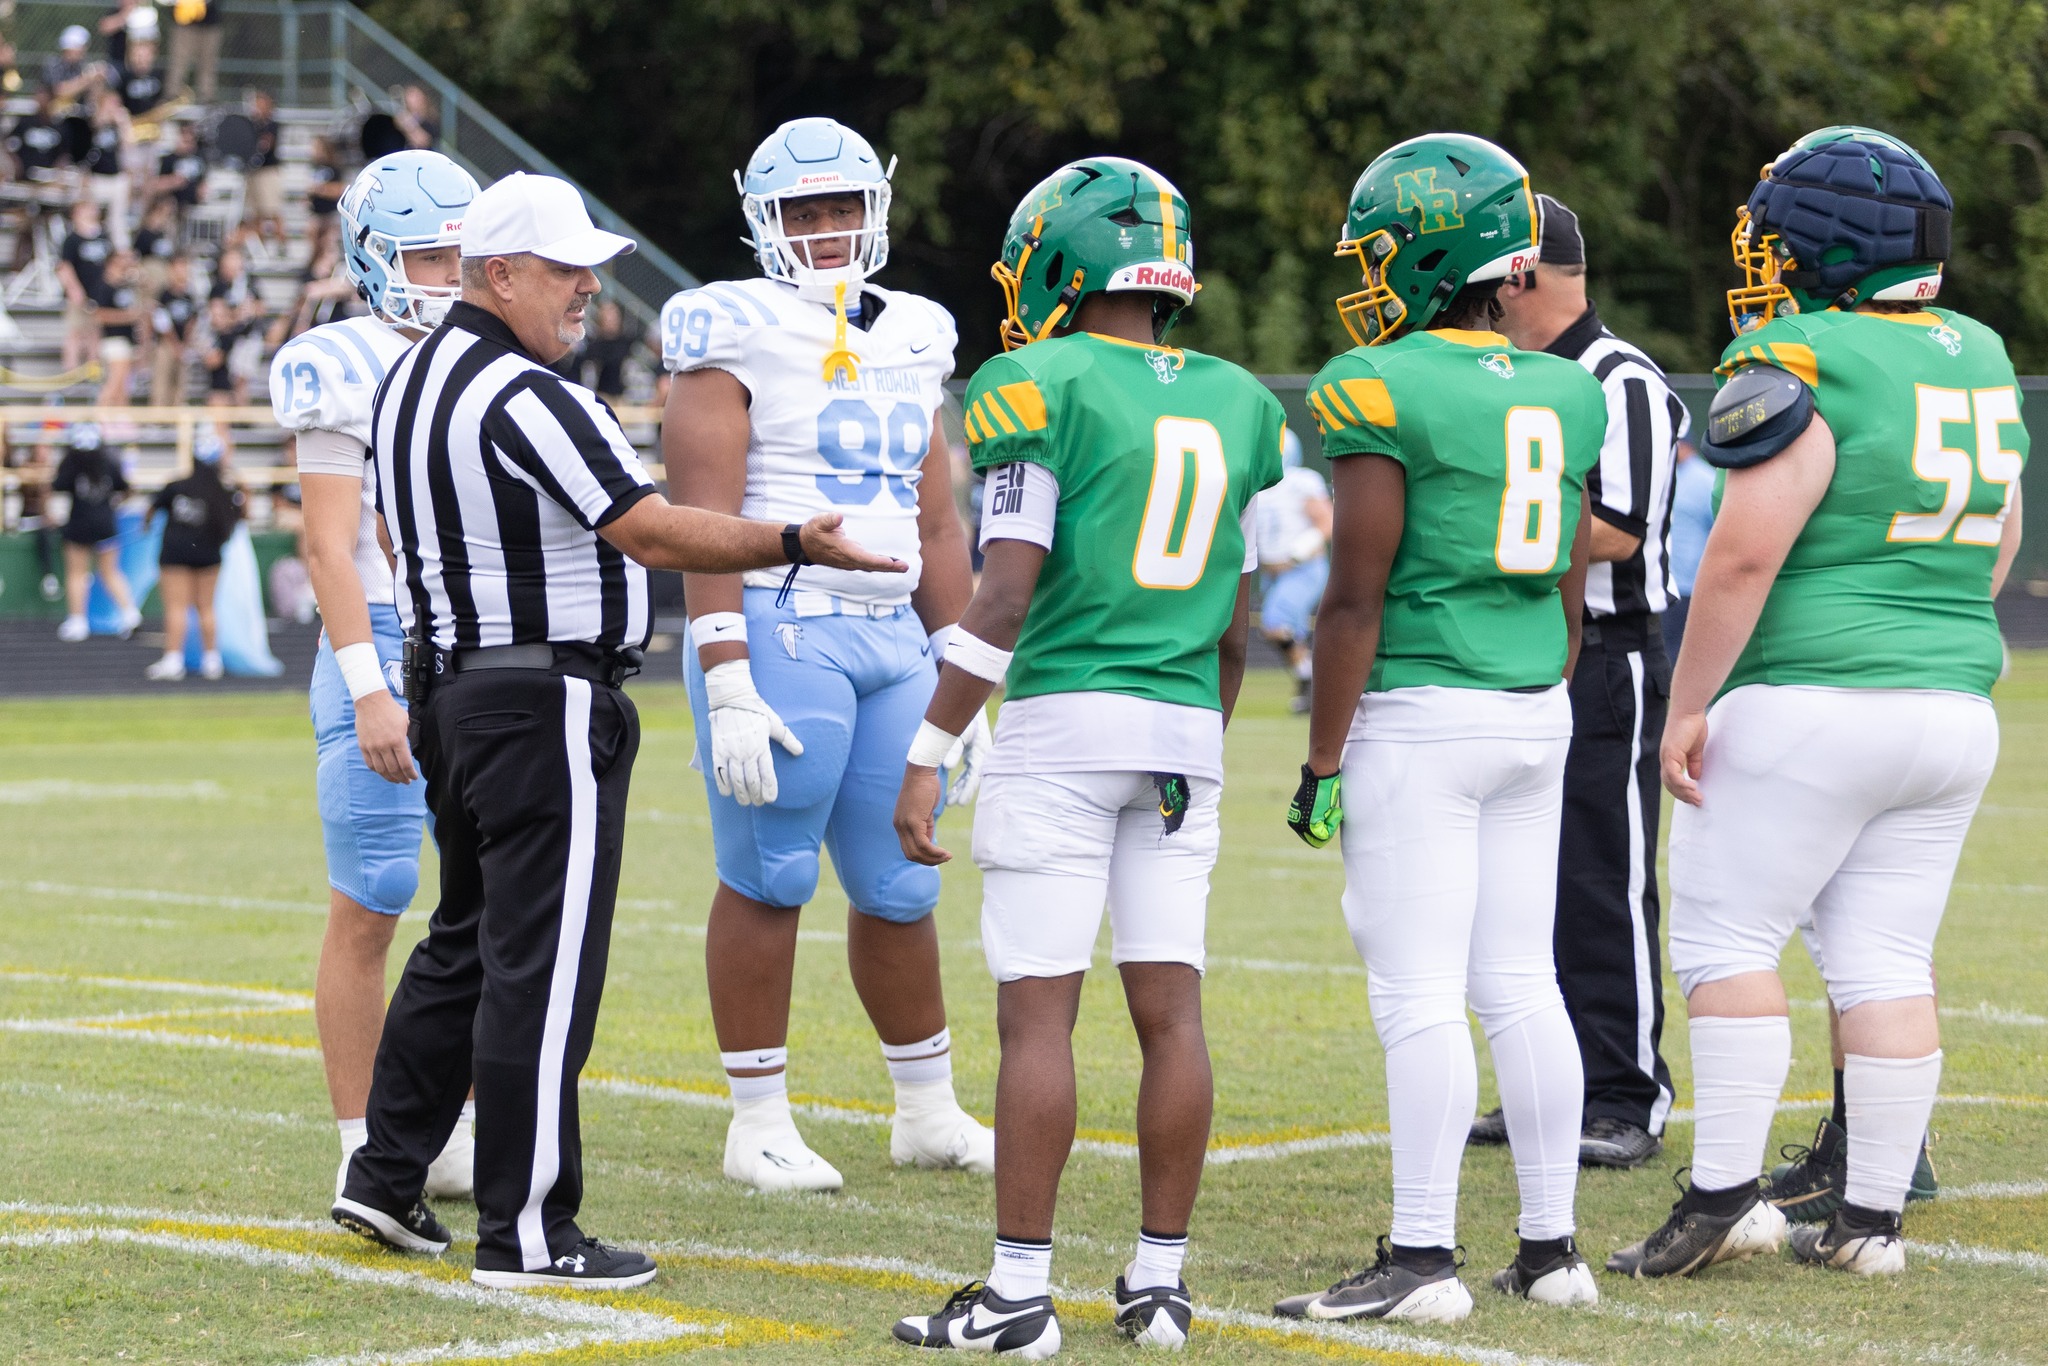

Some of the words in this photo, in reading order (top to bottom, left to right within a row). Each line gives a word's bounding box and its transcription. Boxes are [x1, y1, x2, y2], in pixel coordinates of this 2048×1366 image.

[281, 362, 321, 413] 13
[664, 306, 712, 358] 99
[815, 399, 927, 509] 99
[1132, 415, 1228, 591] 0
[1495, 405, 1564, 574] 8
[1885, 382, 2020, 547] 55
